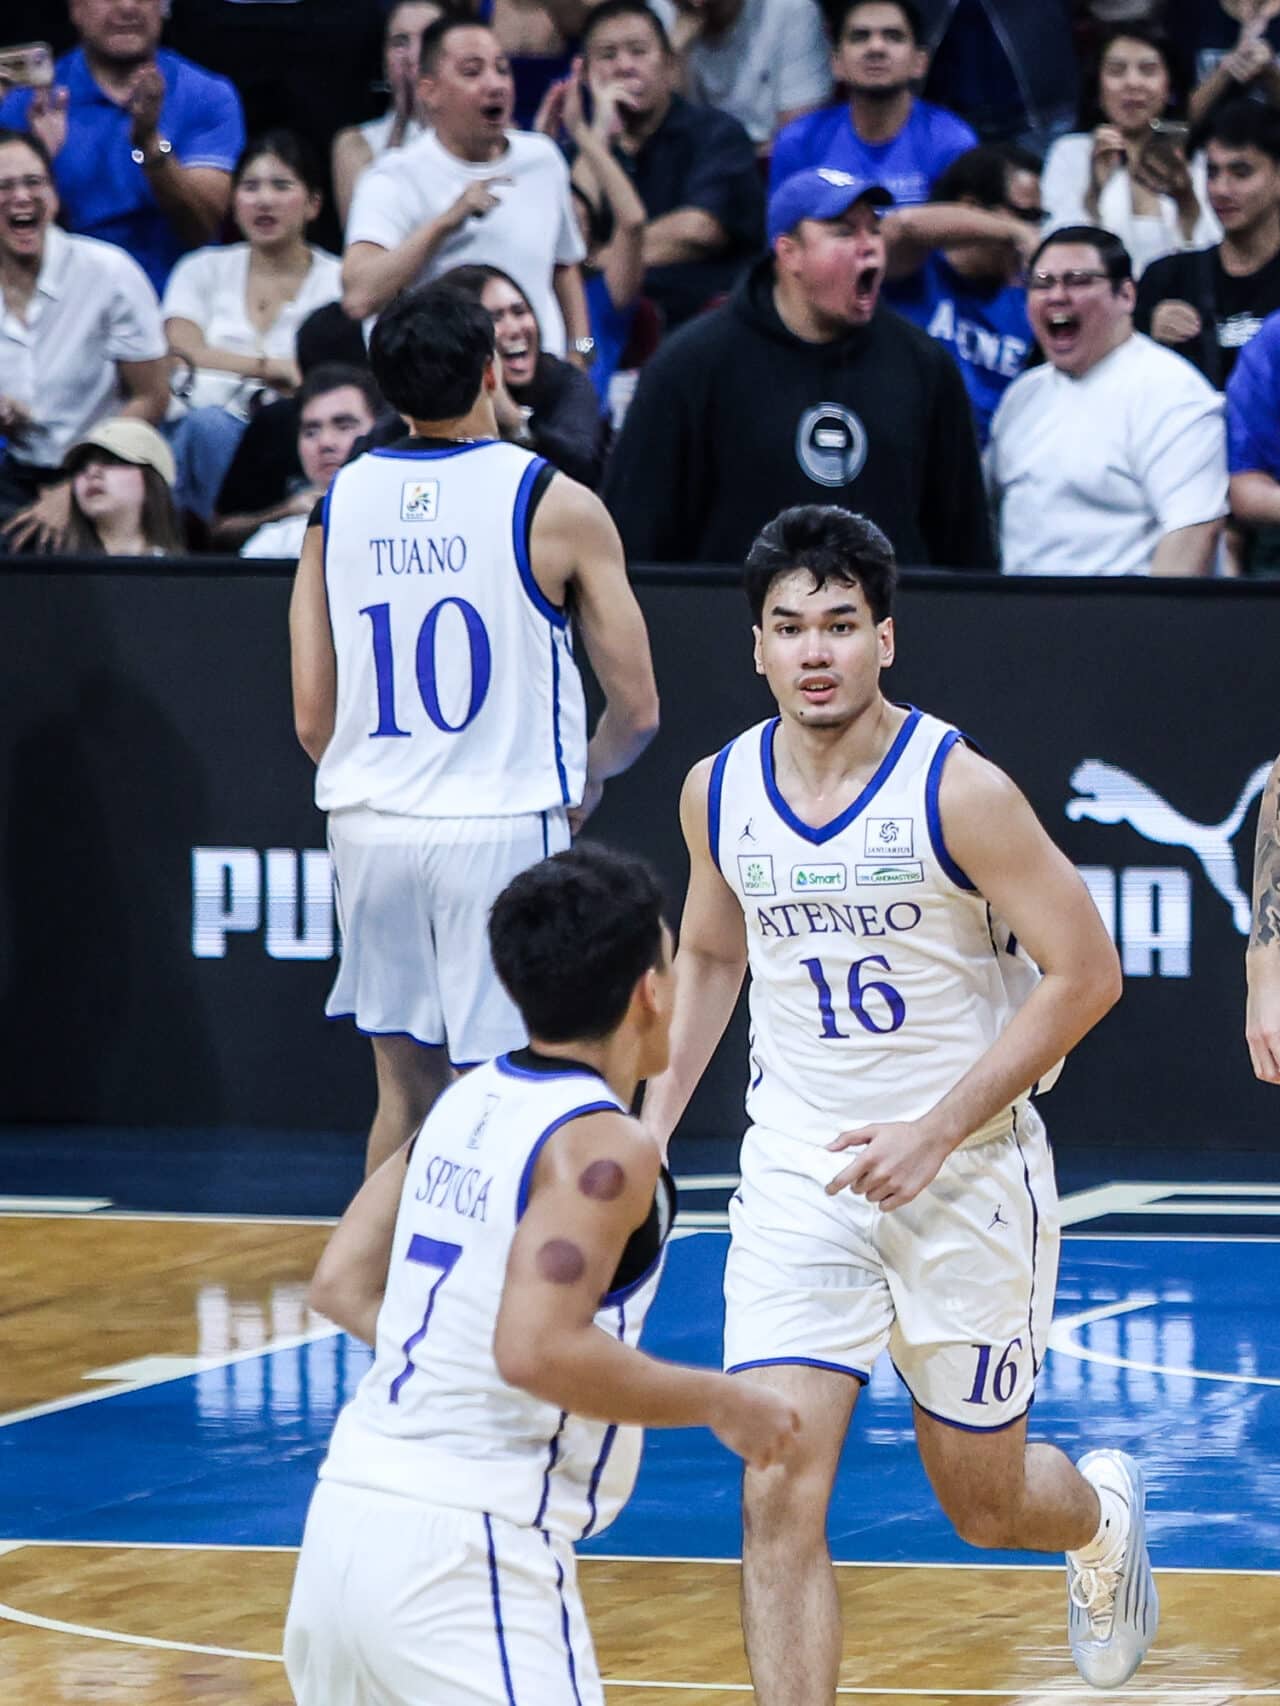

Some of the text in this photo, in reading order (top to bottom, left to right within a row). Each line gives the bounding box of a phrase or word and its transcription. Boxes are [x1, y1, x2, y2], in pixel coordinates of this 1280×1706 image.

[369, 535, 467, 576] TUANO
[358, 596, 492, 738] 10
[809, 872, 841, 885] Smart
[757, 901, 922, 938] ATENEO
[800, 955, 906, 1039] 16
[389, 1233, 463, 1405] 7
[962, 1337, 1023, 1405] 16
